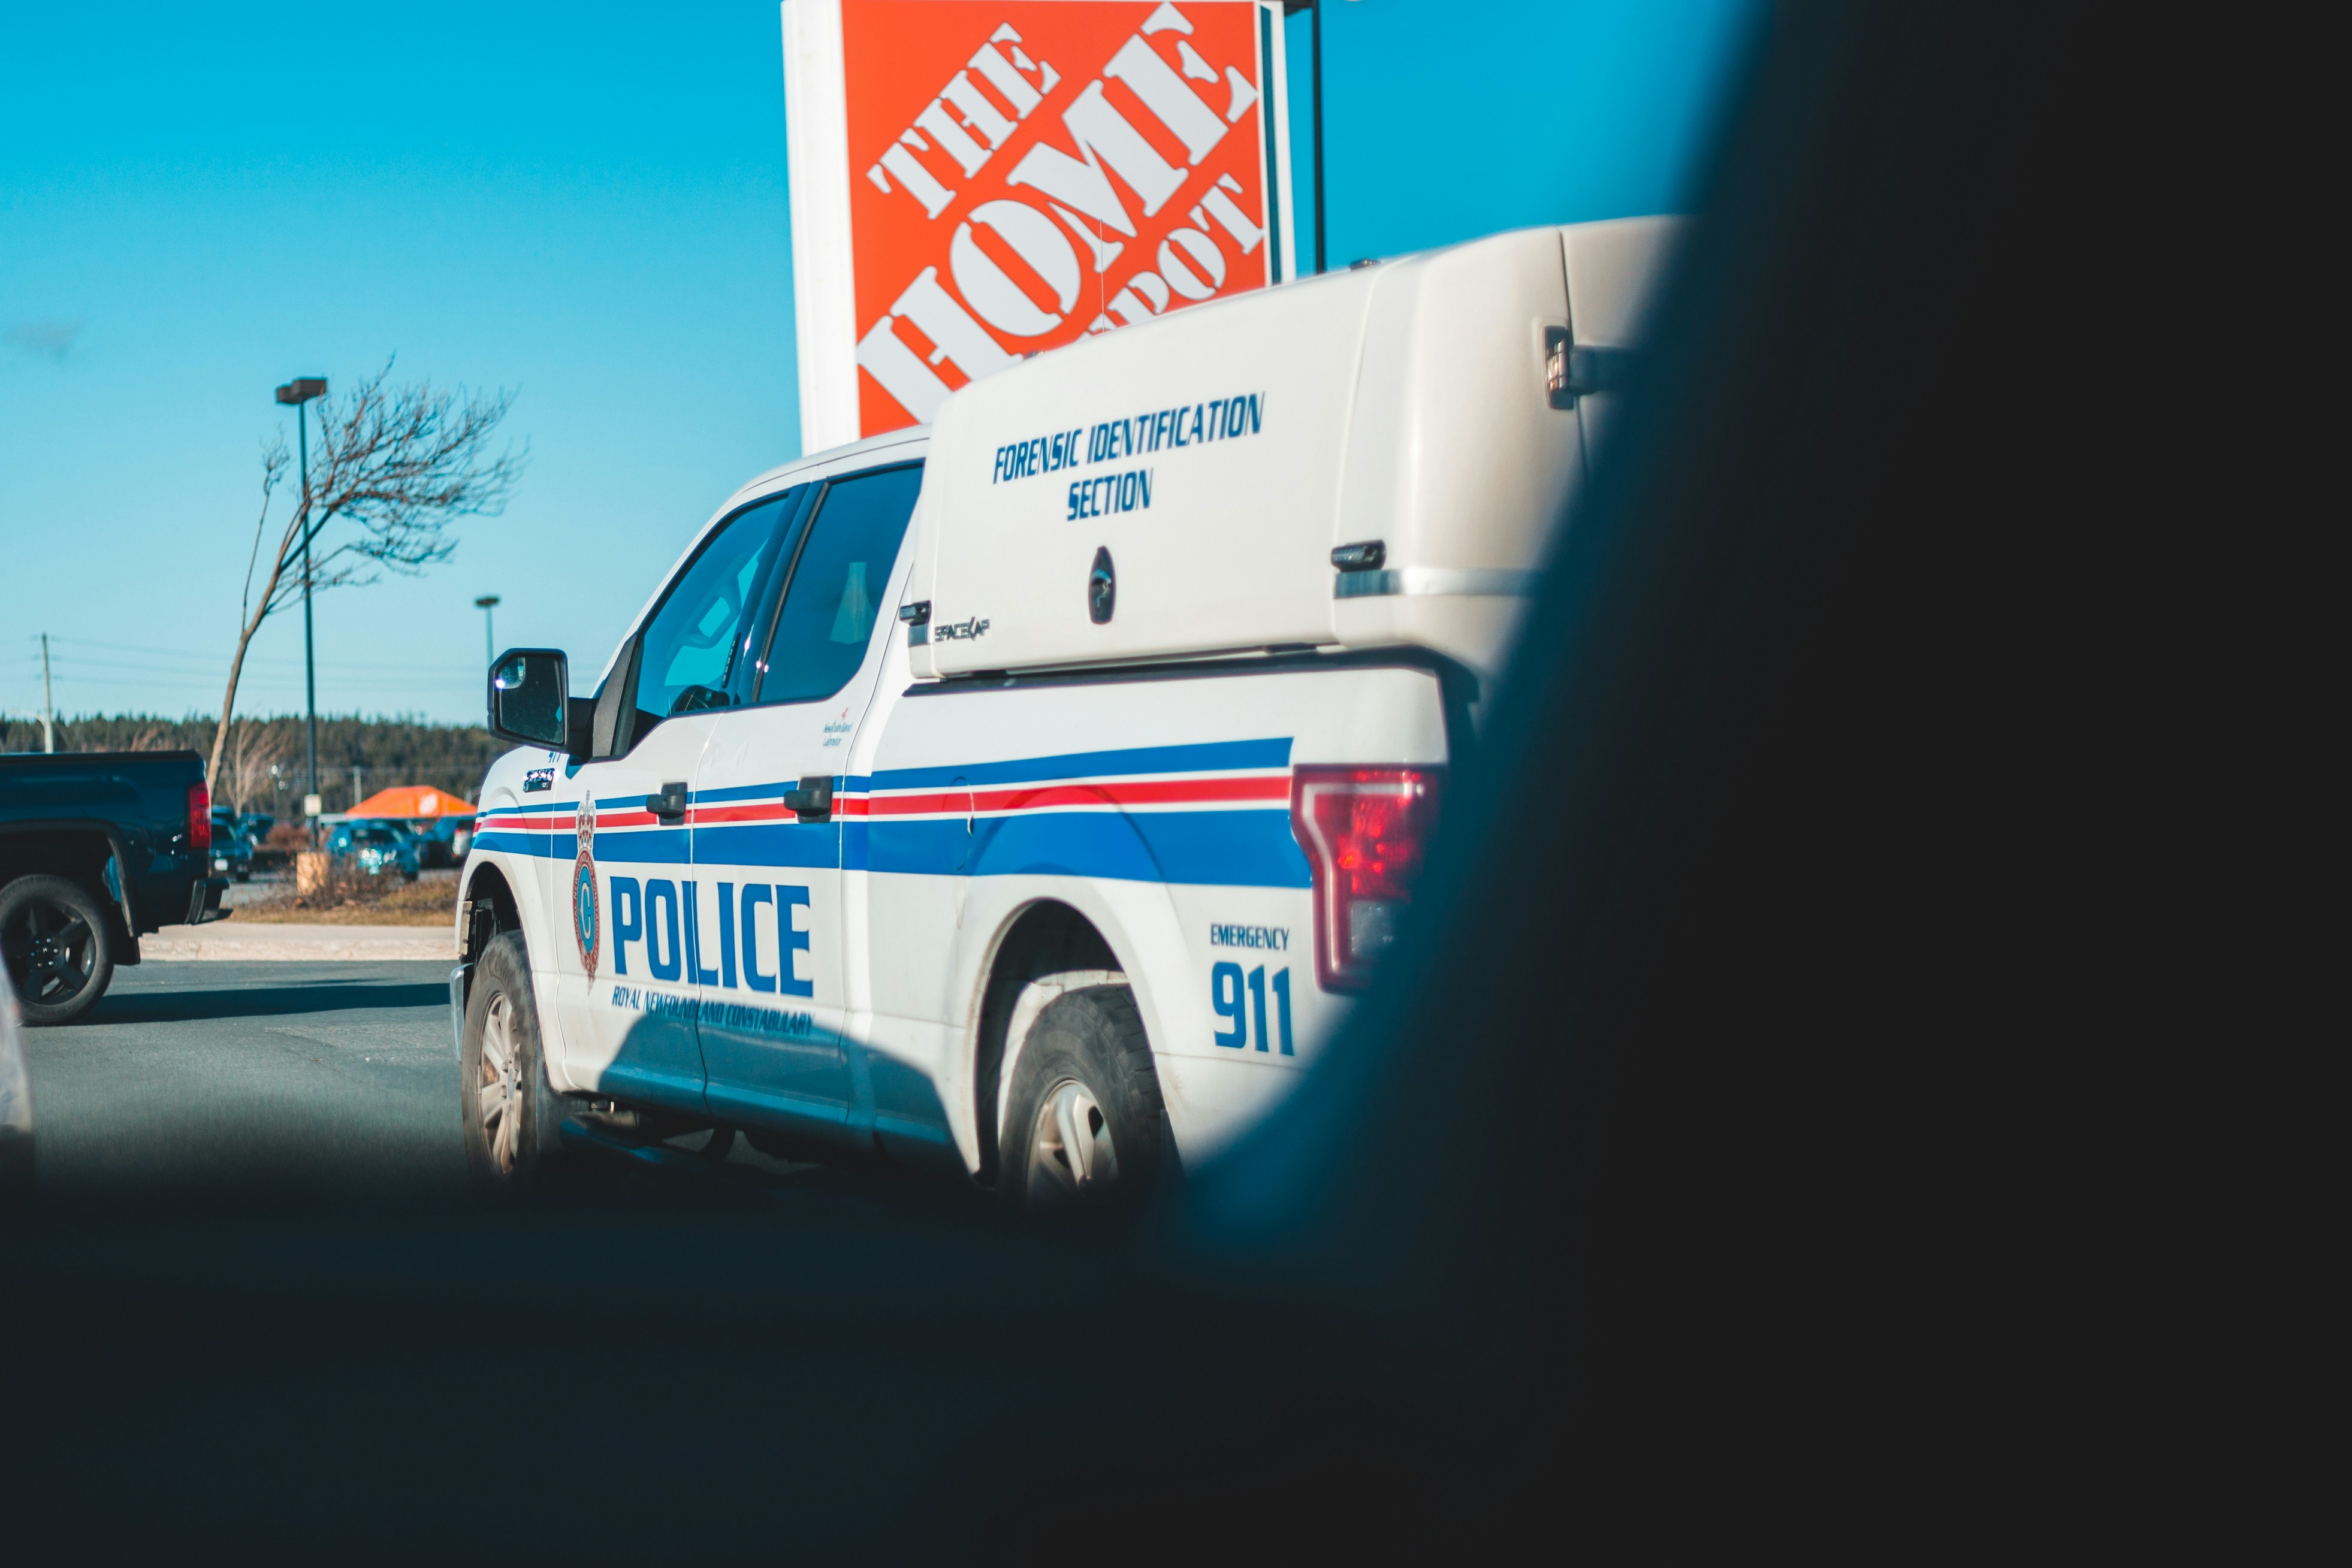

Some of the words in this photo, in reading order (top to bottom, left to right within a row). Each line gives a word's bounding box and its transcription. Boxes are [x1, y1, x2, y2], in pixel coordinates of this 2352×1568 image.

[866, 21, 1062, 220] THE
[857, 1, 1259, 424] HOME
[1079, 172, 1266, 343] POT
[993, 428, 1083, 485] FORENSIC
[1086, 391, 1266, 465] IDENTIFICATION
[1067, 467, 1154, 522] SECTION
[609, 876, 814, 998] POLICE
[1210, 923, 1290, 951] EMERGENCY
[612, 985, 641, 1010] ROYAL
[643, 989, 726, 1025] NEWFOUNDLAND
[726, 1002, 816, 1036] CONSTABULARY
[1211, 960, 1294, 1056] 911
